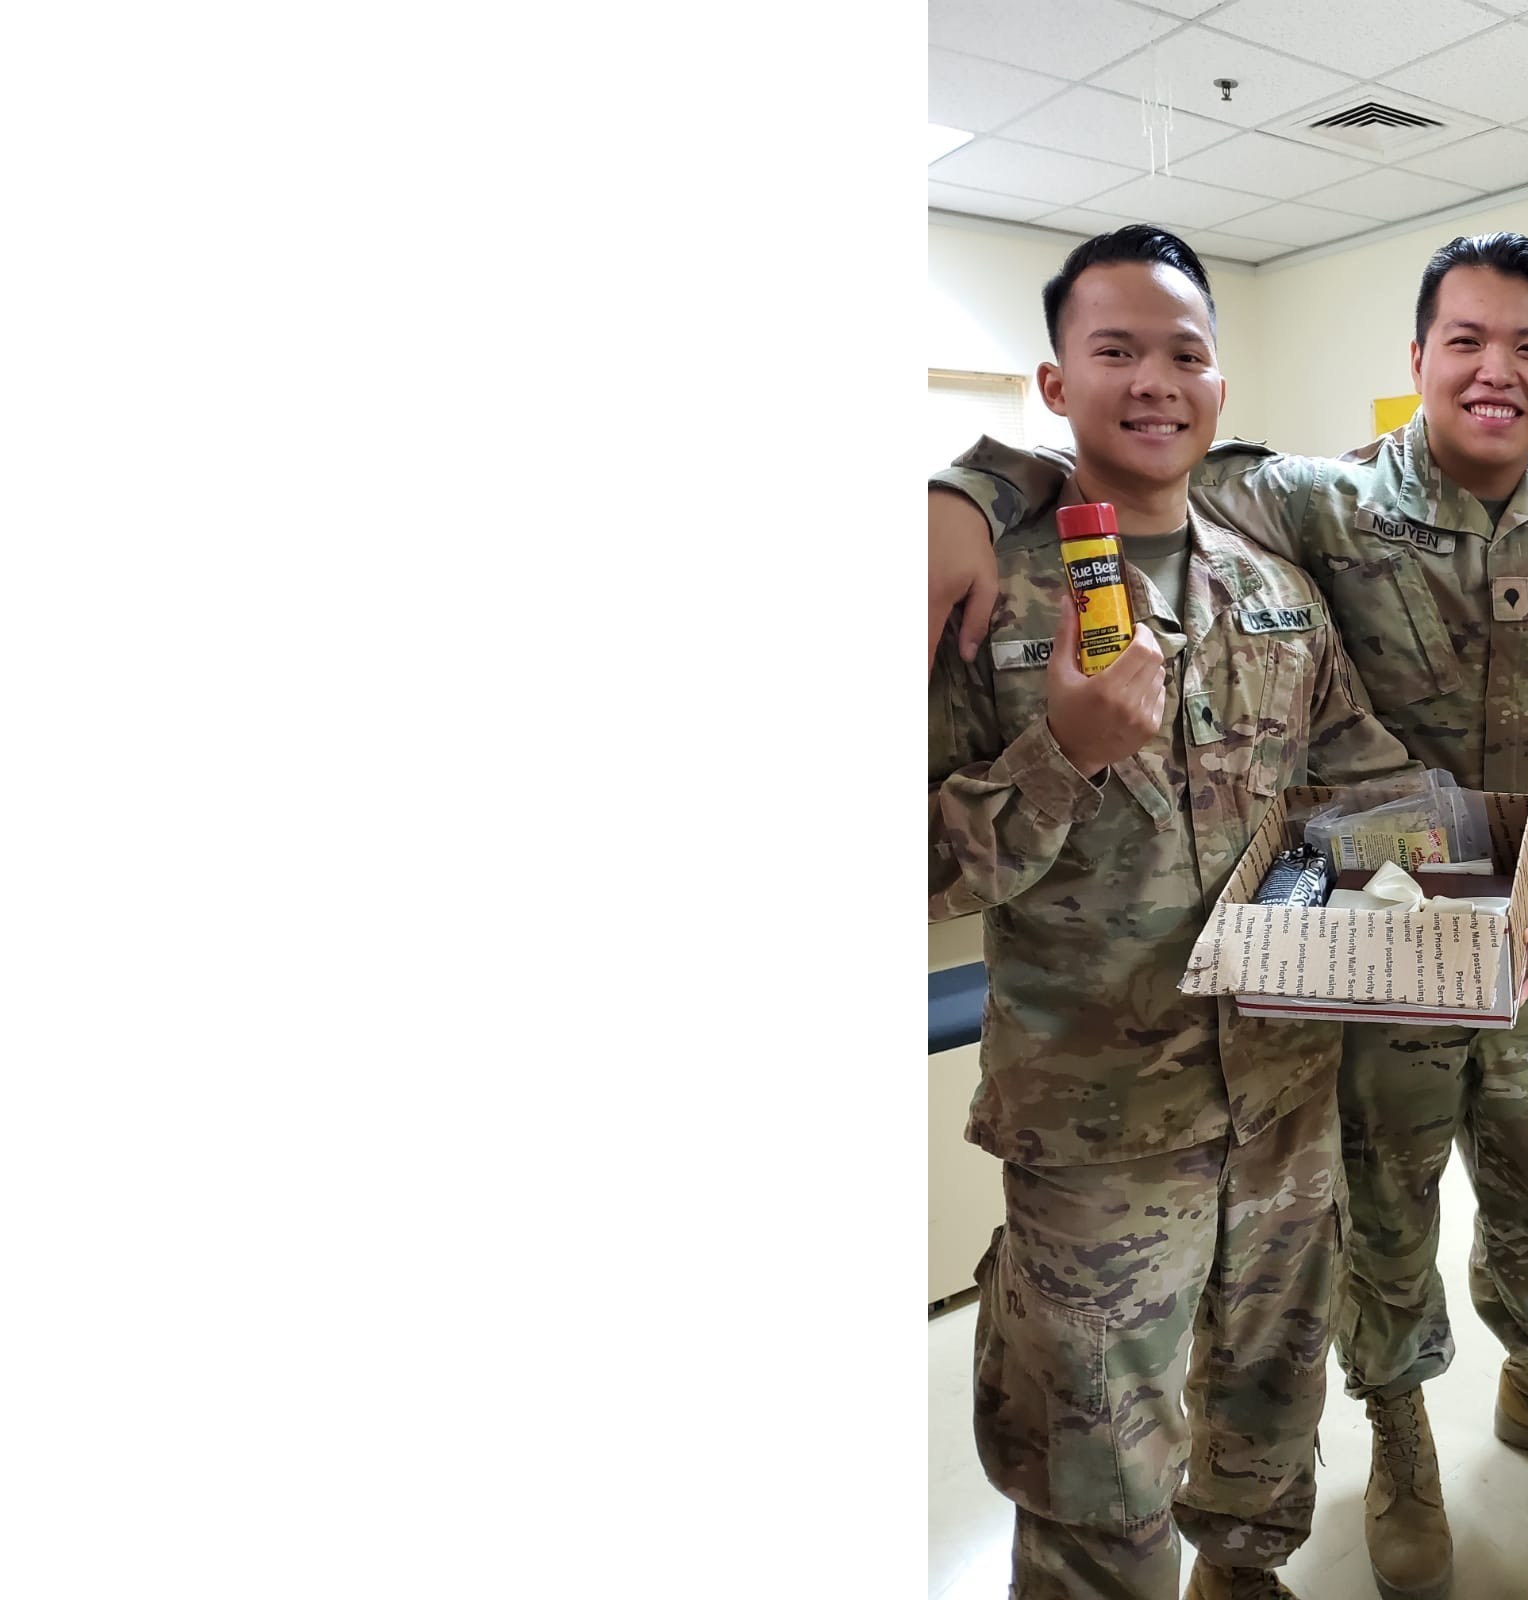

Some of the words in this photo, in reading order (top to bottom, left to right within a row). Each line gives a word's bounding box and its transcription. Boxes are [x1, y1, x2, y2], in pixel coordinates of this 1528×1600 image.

[1373, 514, 1439, 548] NGUYEN
[1071, 566, 1092, 580] Sue
[1092, 561, 1117, 575] Bee
[1073, 578, 1093, 589] Clover
[1095, 575, 1121, 584] Honey
[1248, 612, 1279, 630] U.S.
[1277, 608, 1312, 628] ARMY
[1022, 640, 1054, 663] NG
[1245, 917, 1256, 941] Thank
[1283, 909, 1293, 935] Service
[1319, 909, 1327, 939] required
[1330, 921, 1339, 944] Thank
[1368, 913, 1376, 938] Service
[1403, 913, 1413, 943] required
[1452, 916, 1461, 944] Service
[1488, 917, 1500, 949] required
[1261, 924, 1273, 956] Priority
[1348, 928, 1357, 956] Priority
[1416, 925, 1425, 948] Thank
[1434, 933, 1444, 961] Priority
[1297, 943, 1307, 975] postage
[1329, 945, 1337, 959] you
[1385, 947, 1393, 978] postage
[1416, 950, 1424, 964] you
[1277, 960, 1289, 990] Priority
[1329, 959, 1338, 973] for
[1417, 966, 1425, 978] for
[1472, 953, 1482, 985] postage
[1327, 974, 1337, 996] using
[1366, 965, 1376, 995] Priority
[1417, 980, 1426, 1003] using
[1456, 971, 1466, 1002] Priority
